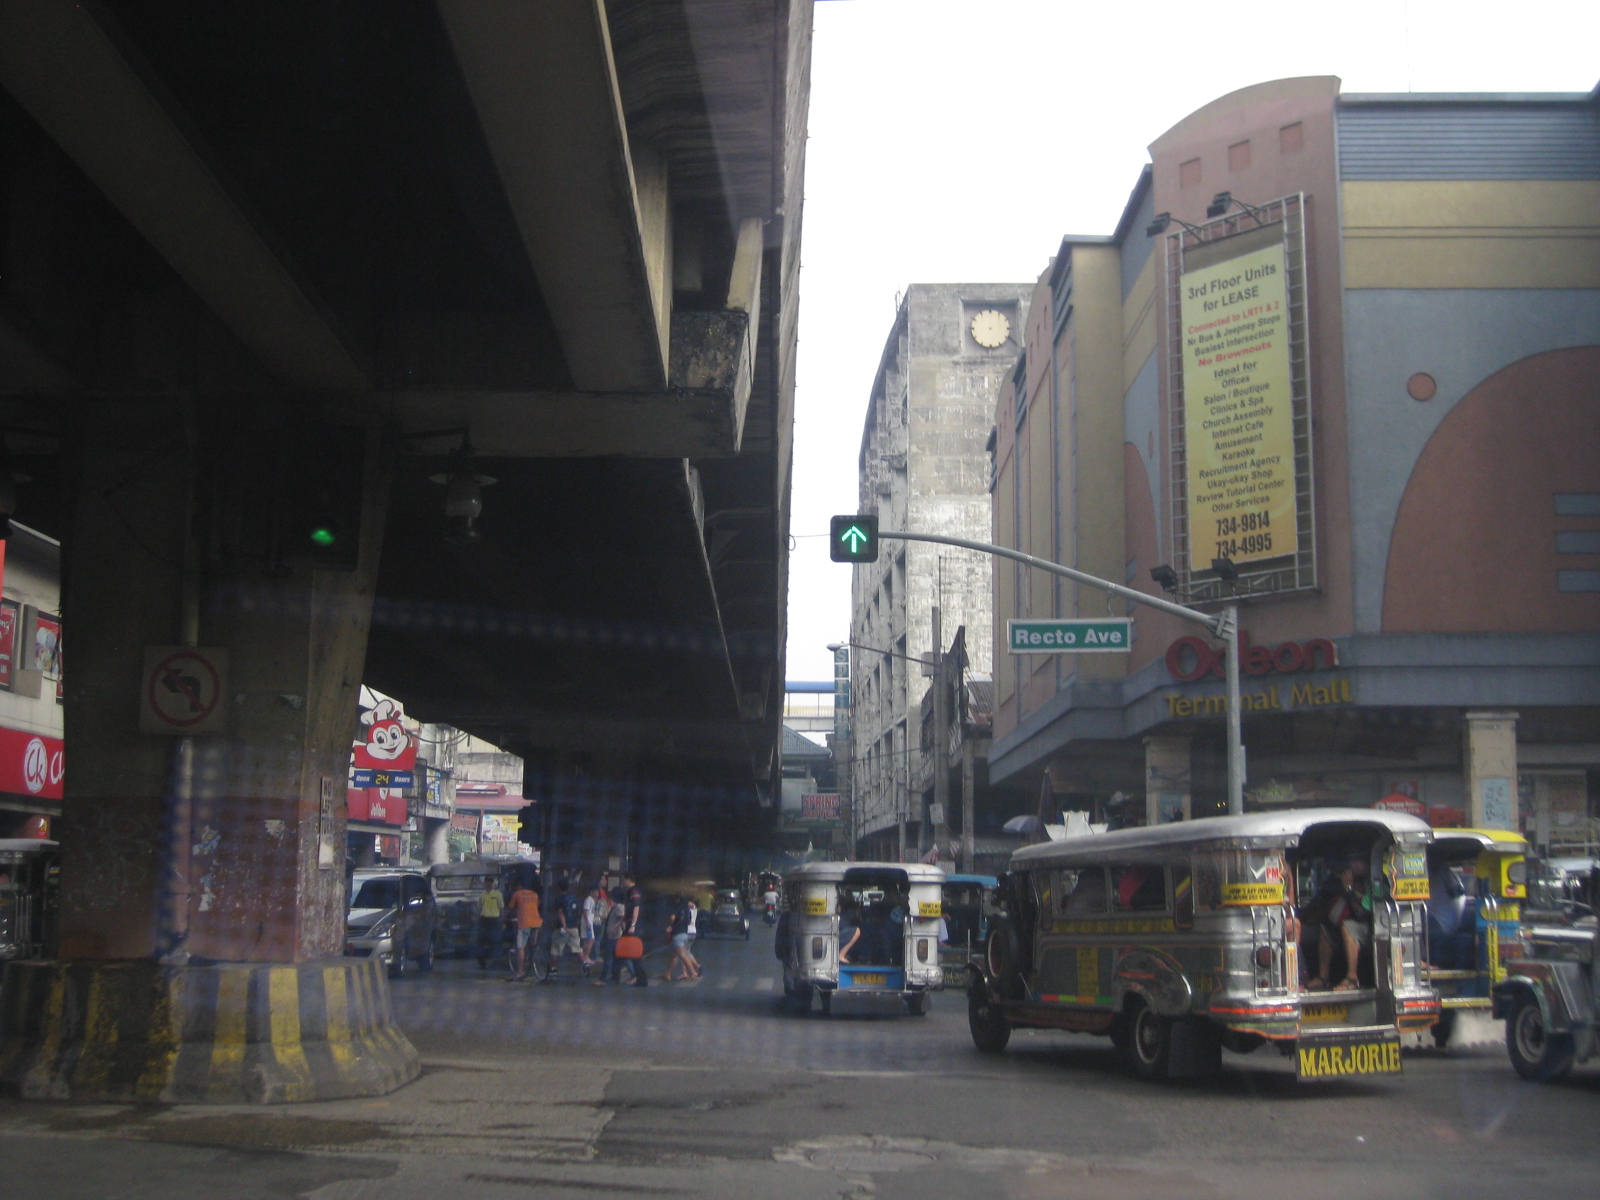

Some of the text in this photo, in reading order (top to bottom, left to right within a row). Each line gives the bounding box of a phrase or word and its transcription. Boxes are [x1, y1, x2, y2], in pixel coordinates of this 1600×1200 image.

[1188, 264, 1276, 300] 3rd Floor Units
[1203, 285, 1260, 312] for LEASE
[1188, 300, 1280, 334] Connected to LRT1 & 2
[1198, 334, 1213, 344] Bus
[1215, 330, 1221, 339] &
[1223, 322, 1256, 337] Jeepney
[1258, 314, 1281, 327] Stops
[1194, 328, 1275, 357] Busiest Intersection
[1198, 341, 1272, 367] No Brownouts
[1214, 361, 1258, 378] Ideal for
[1221, 375, 1250, 389] Offices
[1203, 394, 1227, 405] Salon
[1233, 382, 1270, 398] Boutique
[1210, 396, 1264, 416] Clinics & Spa
[1202, 405, 1274, 430] Church Assembly
[1212, 420, 1264, 439] Internet Cafe
[1214, 433, 1263, 451] Amusement
[1222, 447, 1255, 462] Karaoke
[1199, 454, 1281, 479] Recruitment Agency
[1207, 469, 1273, 489] Ukay-ukay Shop
[1196, 479, 1285, 504] Review Tutorial Center
[1211, 495, 1270, 513] Other Services
[1216, 510, 1270, 537] 734-9814
[1216, 532, 1272, 559] 734-4995
[1015, 628, 1122, 645] Recto Ave
[1165, 629, 1339, 682] Odeon
[1164, 678, 1355, 717] Termnal Mall
[356, 774, 411, 785] Open 24 Hours
[803, 794, 840, 809] SPRING
[1266, 867, 1279, 879] PM
[1299, 1041, 1401, 1078] MARJORIE
